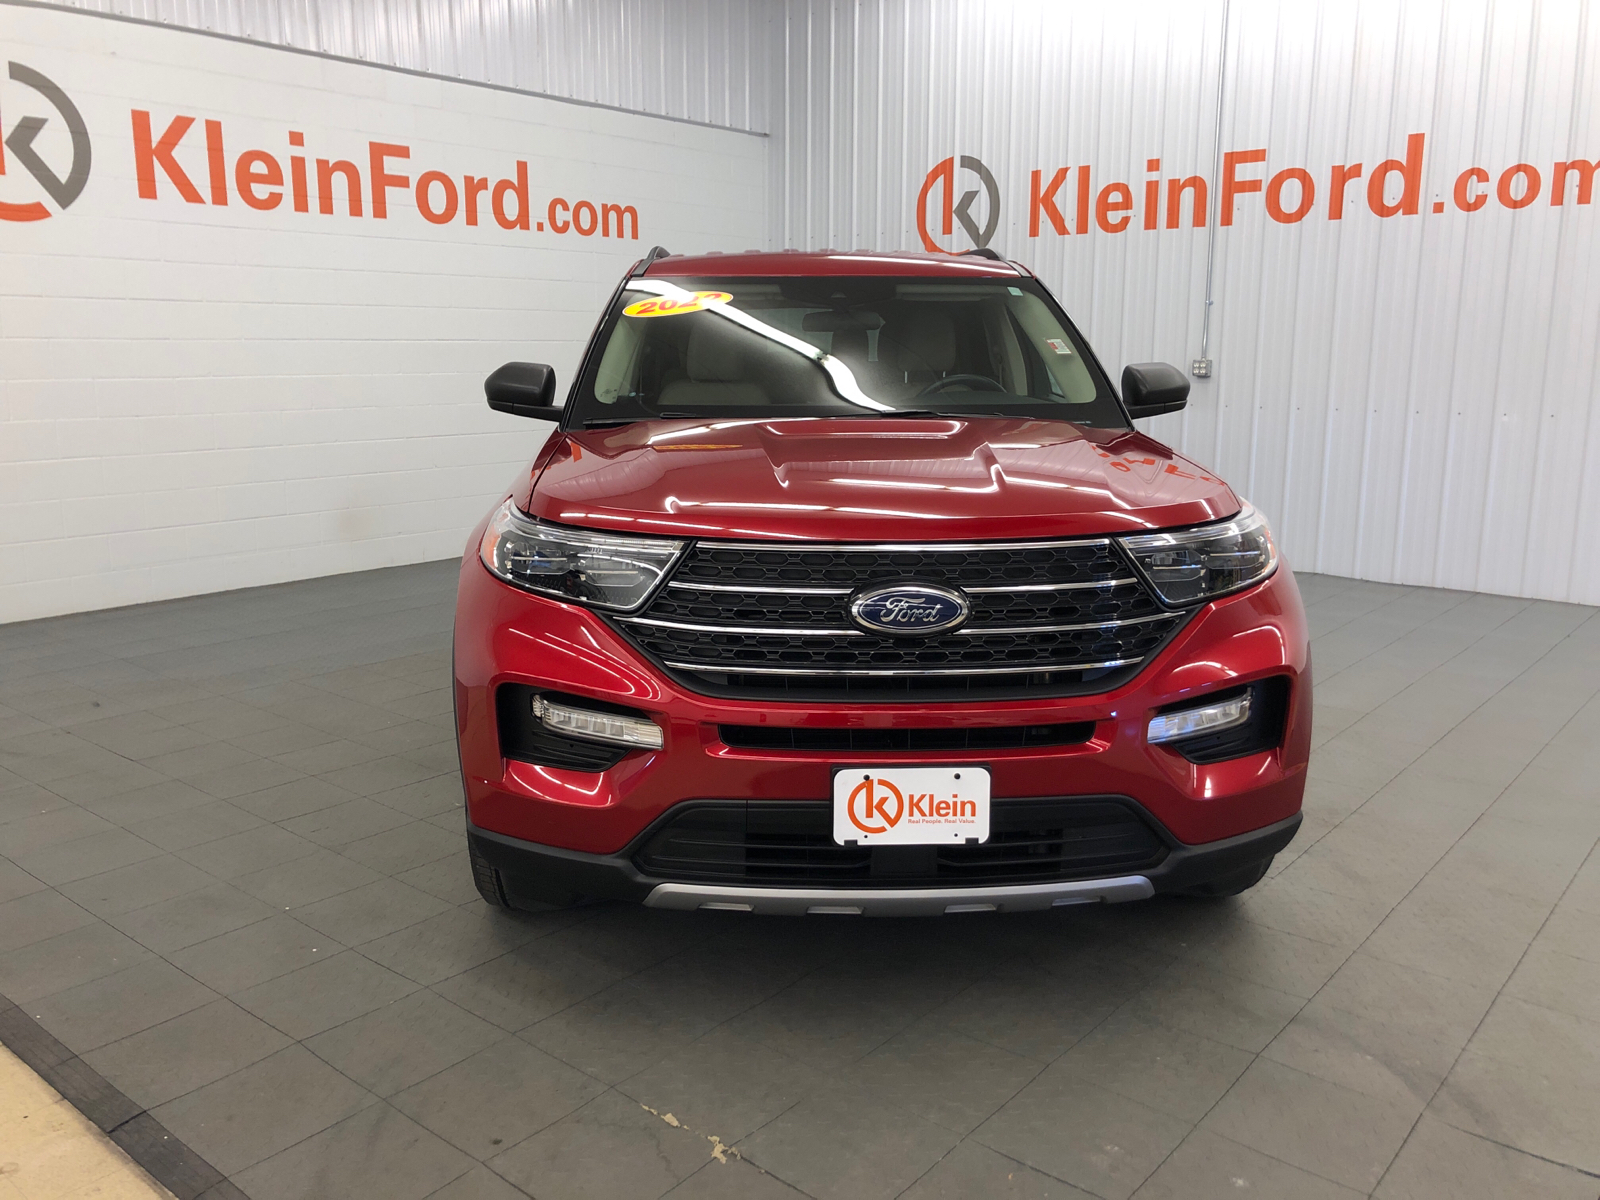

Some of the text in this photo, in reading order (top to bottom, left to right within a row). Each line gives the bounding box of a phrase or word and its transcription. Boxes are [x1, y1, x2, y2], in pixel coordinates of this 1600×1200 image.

[131, 109, 639, 240] KleinFord.com
[1028, 132, 1600, 238] KleinFord.com
[880, 597, 941, 622] Ford
[908, 793, 977, 818] Klein
